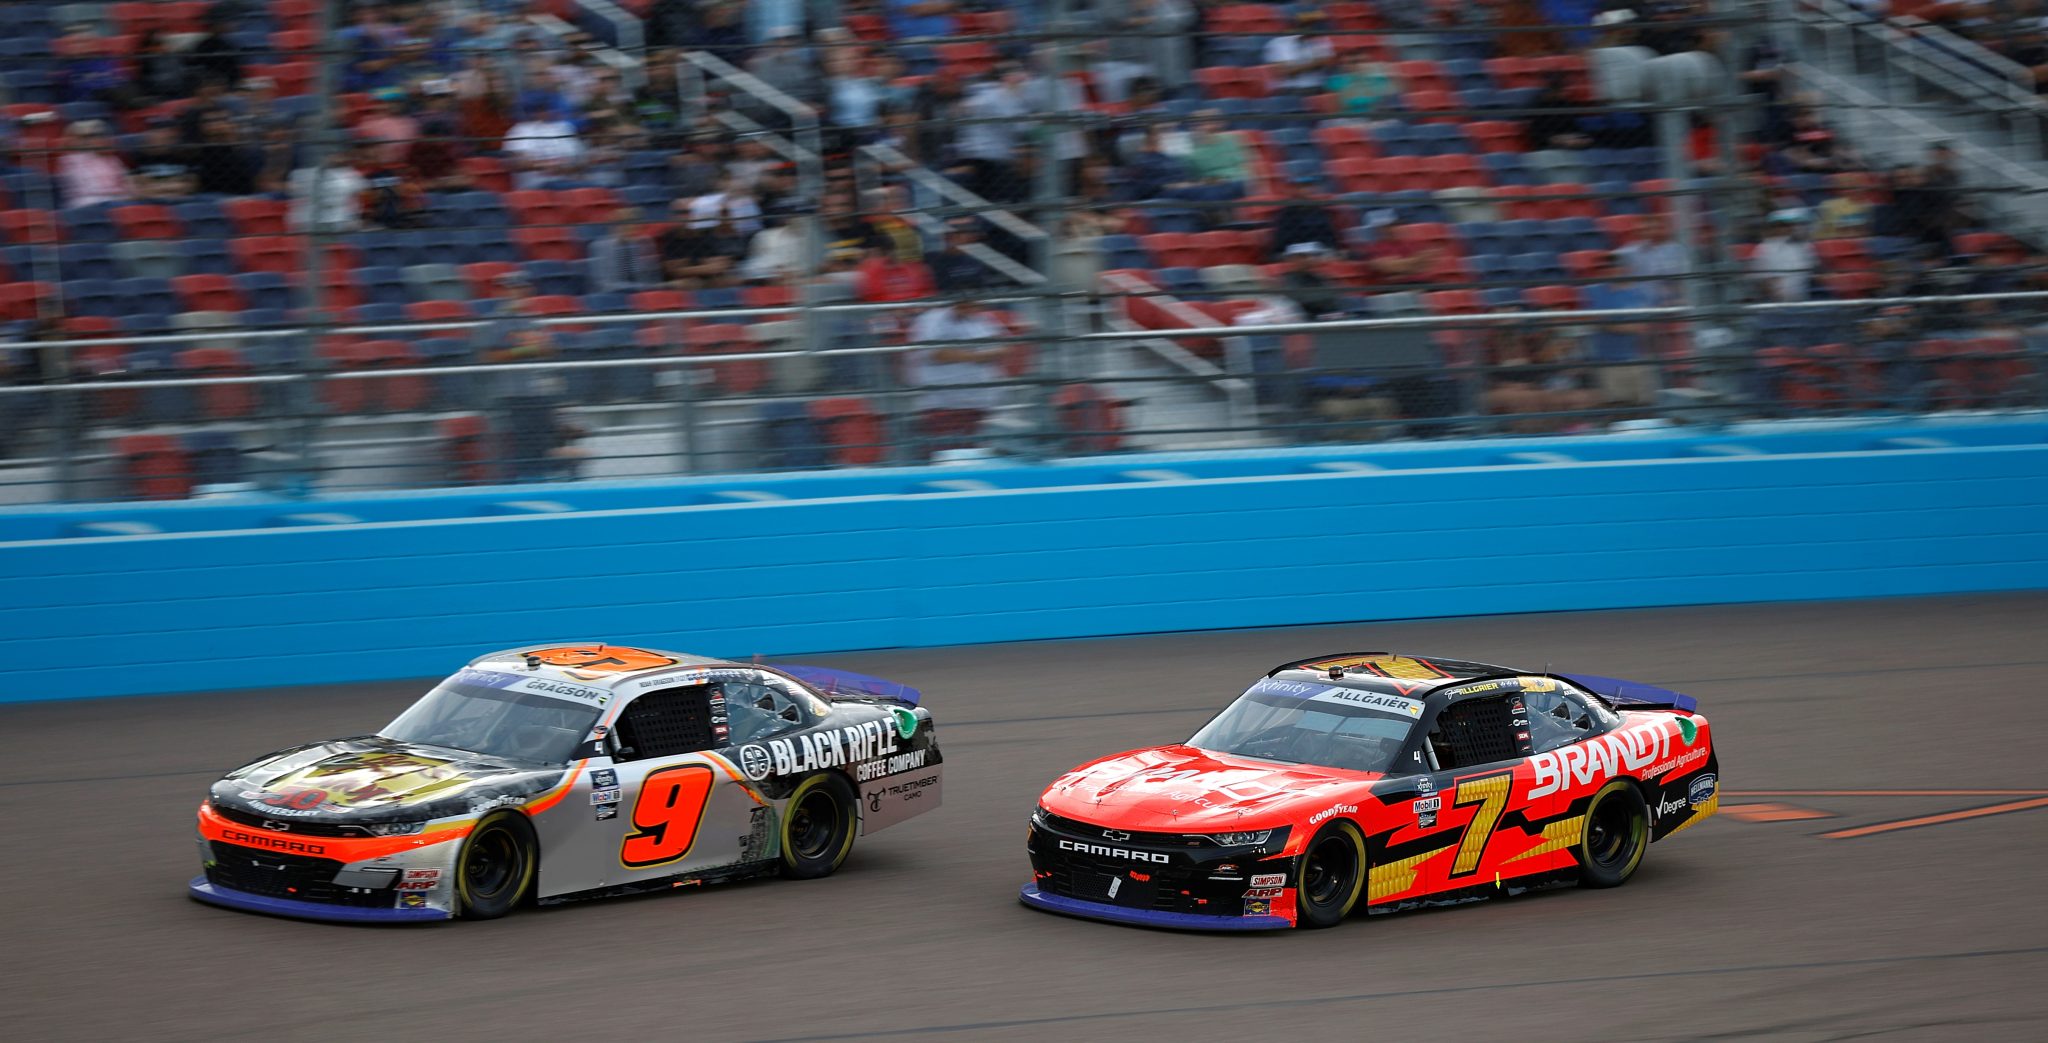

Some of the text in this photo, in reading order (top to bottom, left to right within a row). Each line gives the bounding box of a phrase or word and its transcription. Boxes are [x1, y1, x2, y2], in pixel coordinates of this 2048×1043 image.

[526, 680, 599, 700] GRAGSON
[1258, 682, 1312, 697] xfinity
[1332, 690, 1410, 710] ALLGAIER
[768, 716, 898, 776] BLACK RIFLE
[856, 749, 926, 782] COFFEE COMPANY
[1413, 751, 1421, 764] 4
[1527, 722, 1671, 800] BRANDT
[1641, 746, 1707, 781] Professional Agriculture
[888, 776, 938, 796] TRUETIMBER
[904, 790, 922, 801] CAMO
[1309, 803, 1358, 825] GOODYEAR
[1414, 799, 1432, 812] Mobil
[1663, 797, 1686, 815] Degree
[619, 761, 716, 871] 9
[1448, 769, 1514, 880] 7
[221, 829, 325, 854] CAMARO
[1059, 840, 1169, 864] CAMARO
[397, 880, 437, 890] ARP
[1253, 875, 1283, 886] SIMPSON
[1244, 887, 1282, 897] ARP
